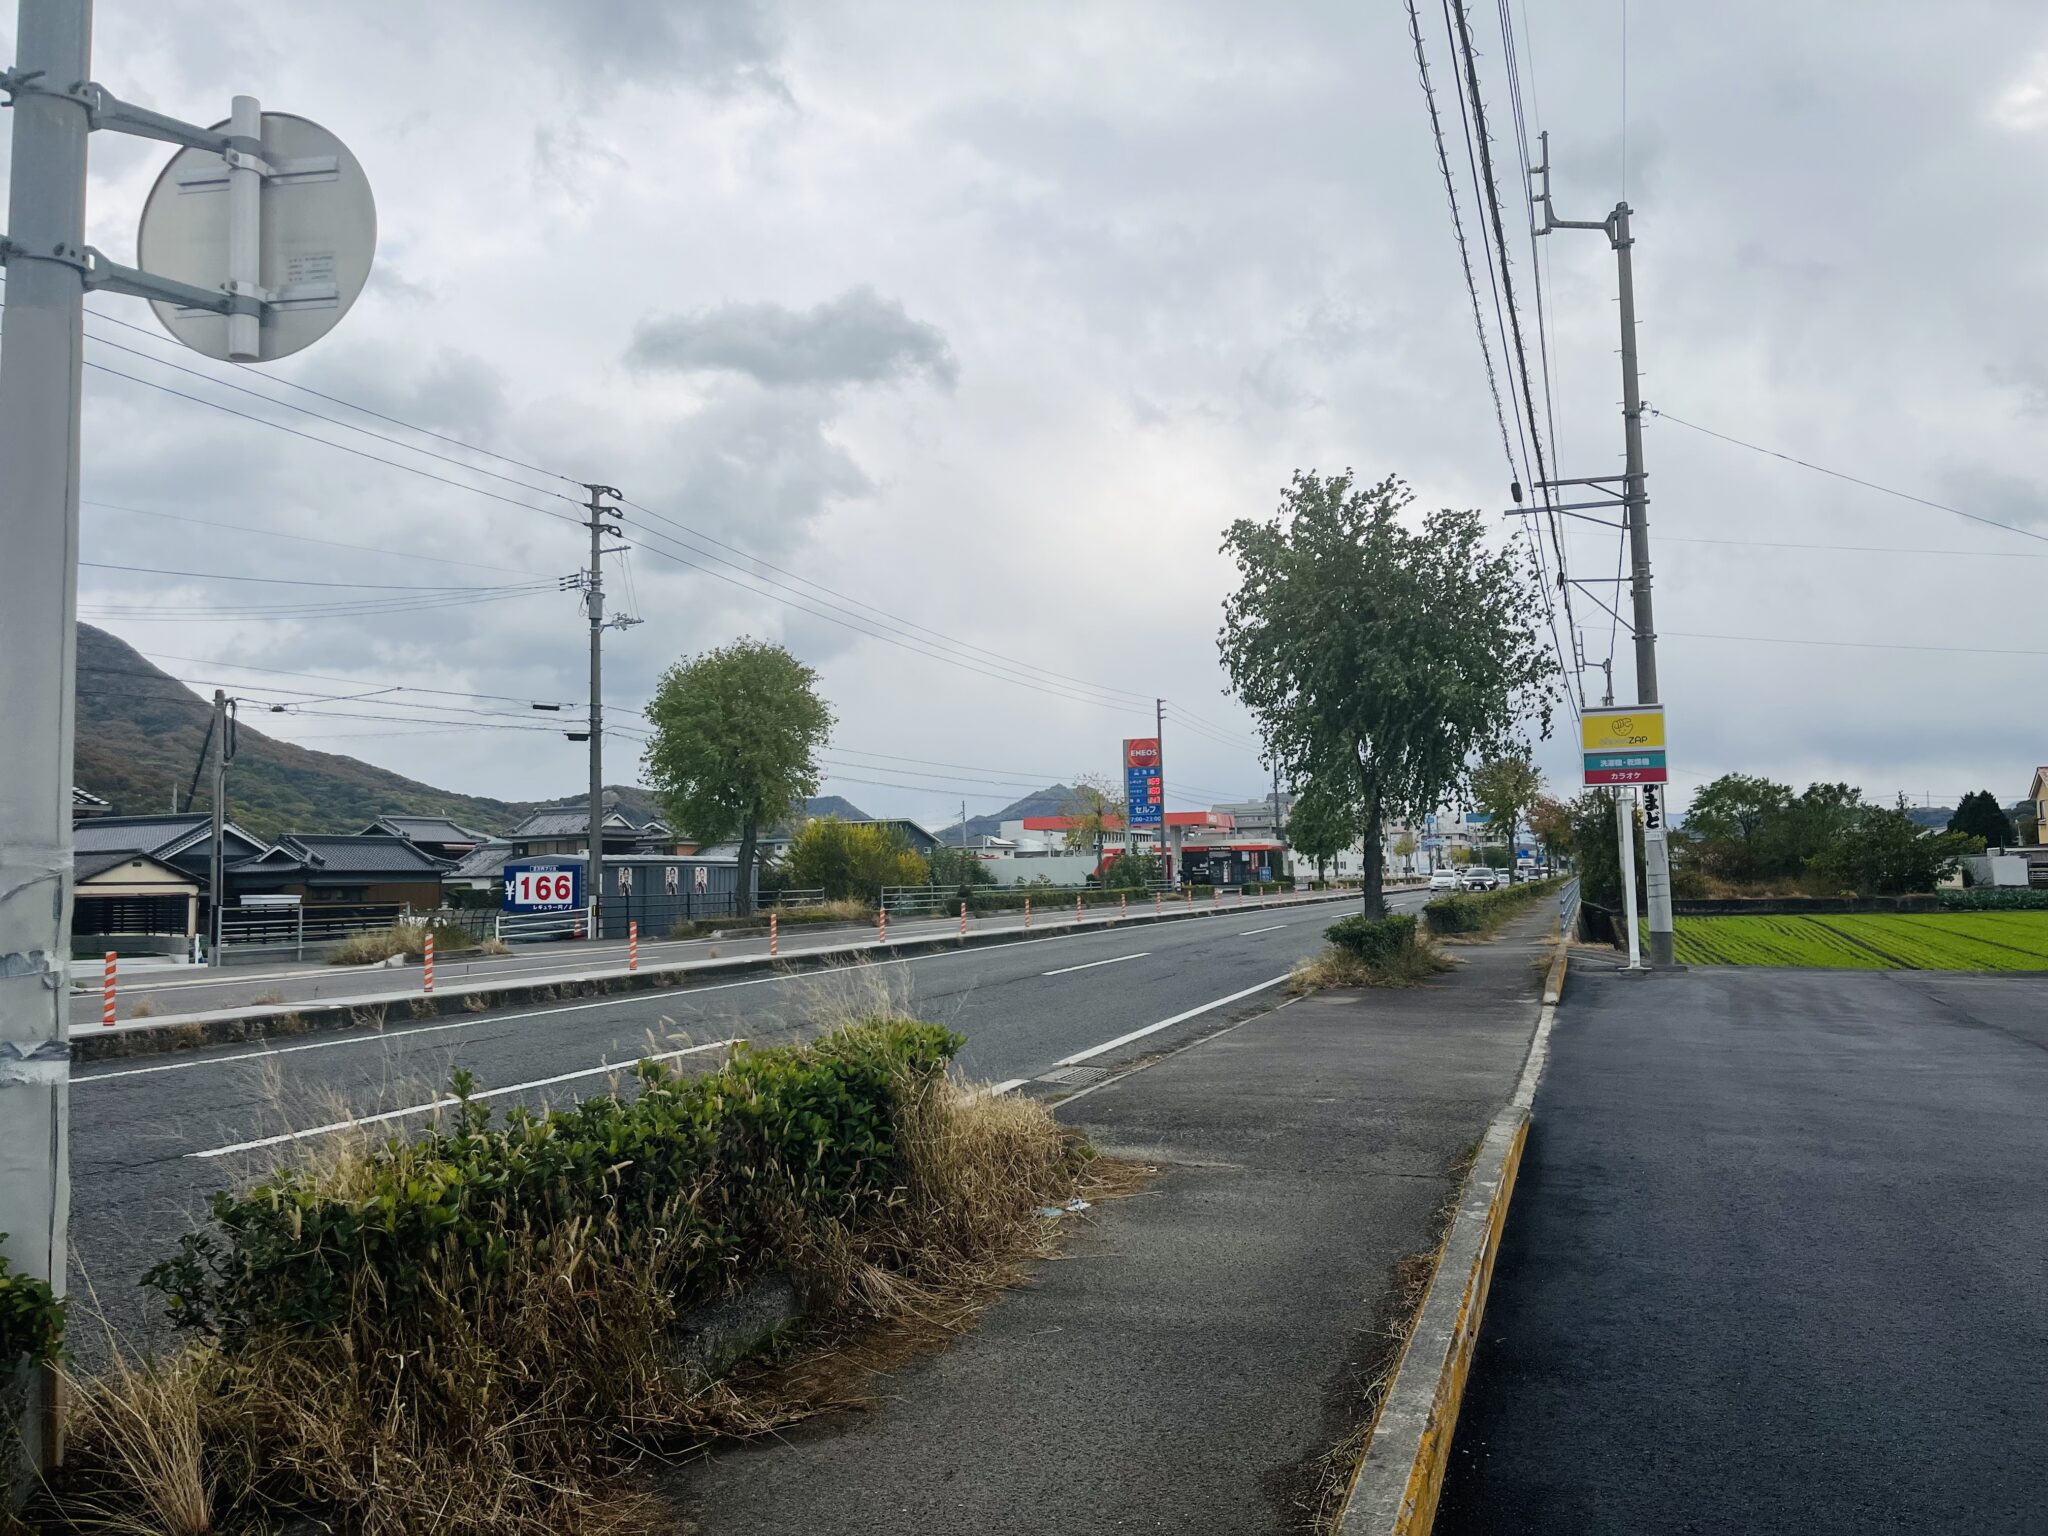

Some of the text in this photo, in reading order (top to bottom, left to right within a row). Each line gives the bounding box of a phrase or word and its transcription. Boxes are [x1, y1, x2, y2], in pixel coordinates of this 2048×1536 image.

[1131, 749, 1158, 757] ENEOS
[1611, 772, 1641, 780] カラオケ
[1135, 806, 1156, 814] セルフ
